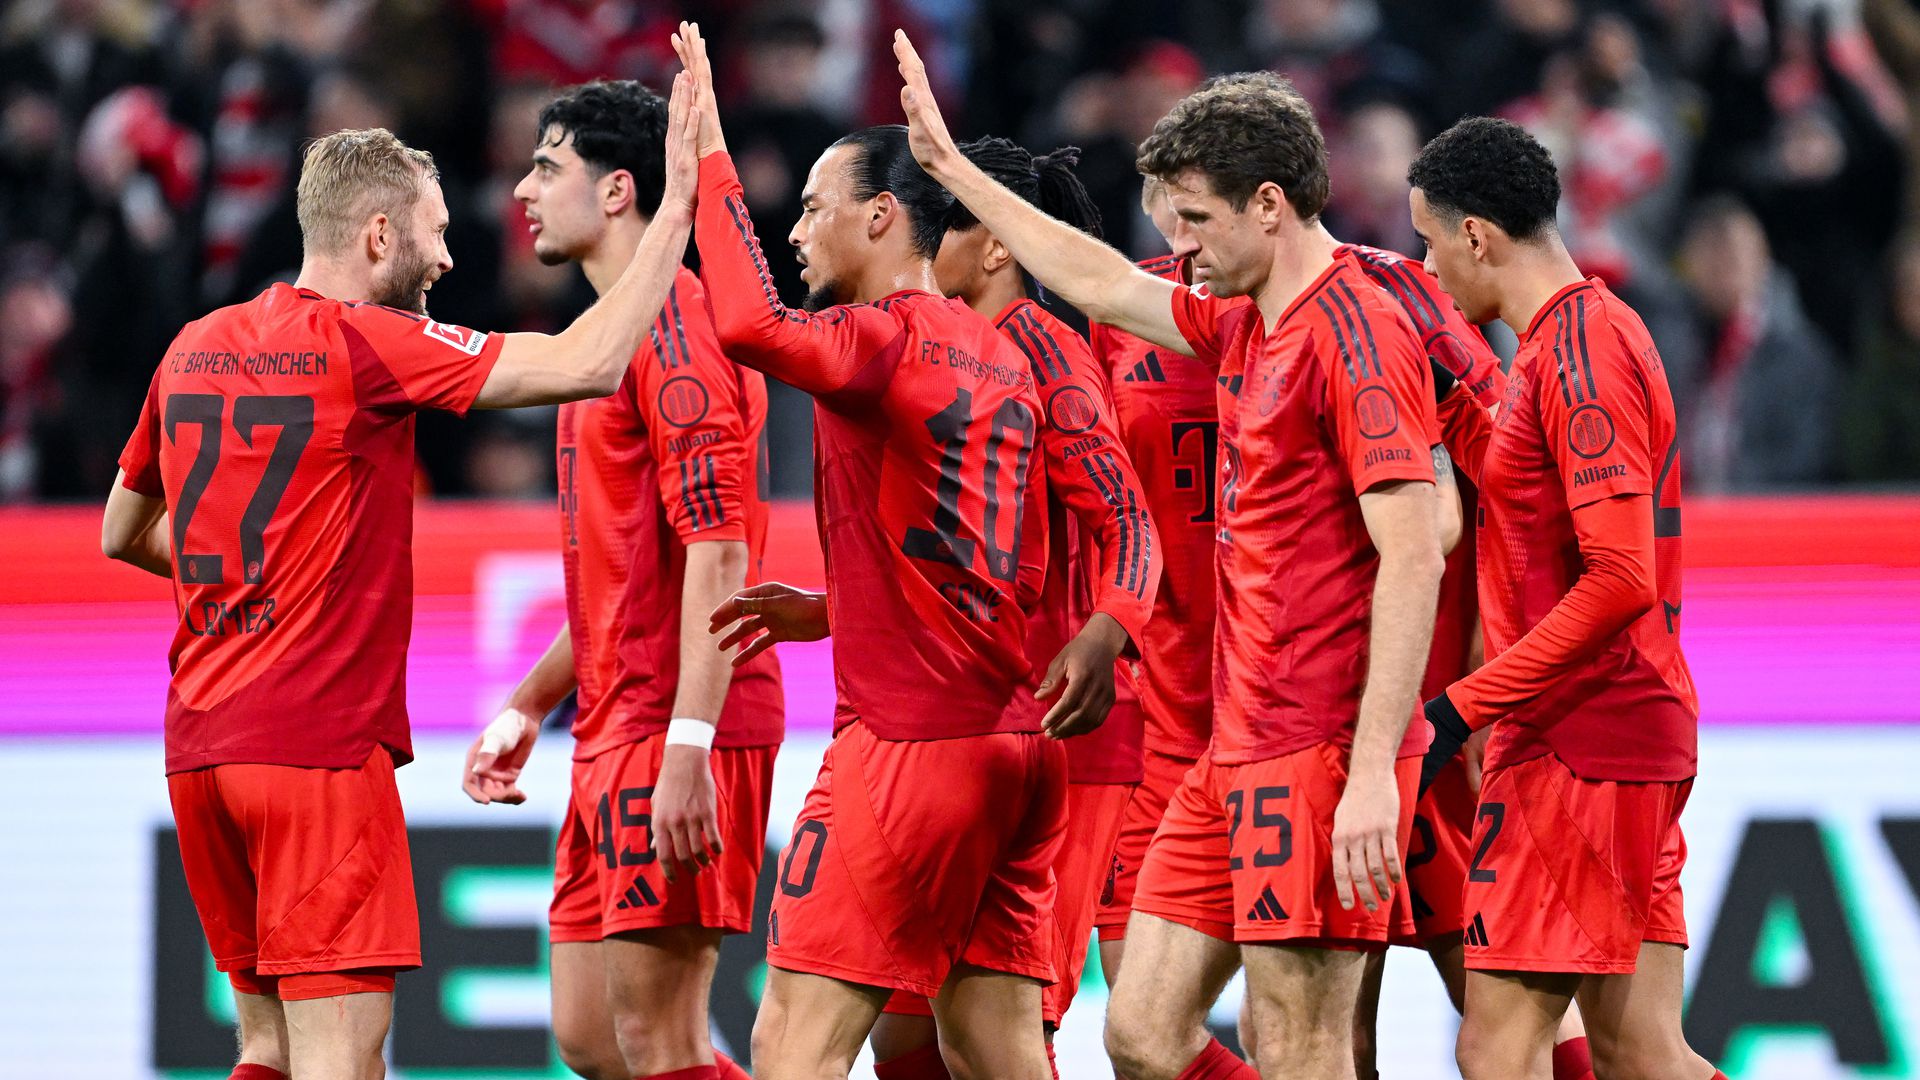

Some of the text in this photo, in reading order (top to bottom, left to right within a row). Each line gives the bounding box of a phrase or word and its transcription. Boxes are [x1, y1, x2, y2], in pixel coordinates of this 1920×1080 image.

[169, 351, 328, 376] FC BAYERN MÜNCHEN
[921, 341, 941, 365] FC
[668, 431, 721, 454] Allianz
[1364, 446, 1412, 471] Allianz
[164, 393, 315, 585] 27
[901, 387, 1037, 583] 10
[1574, 464, 1627, 489] Allianz
[597, 785, 657, 870] 45
[1225, 786, 1293, 871] 25
